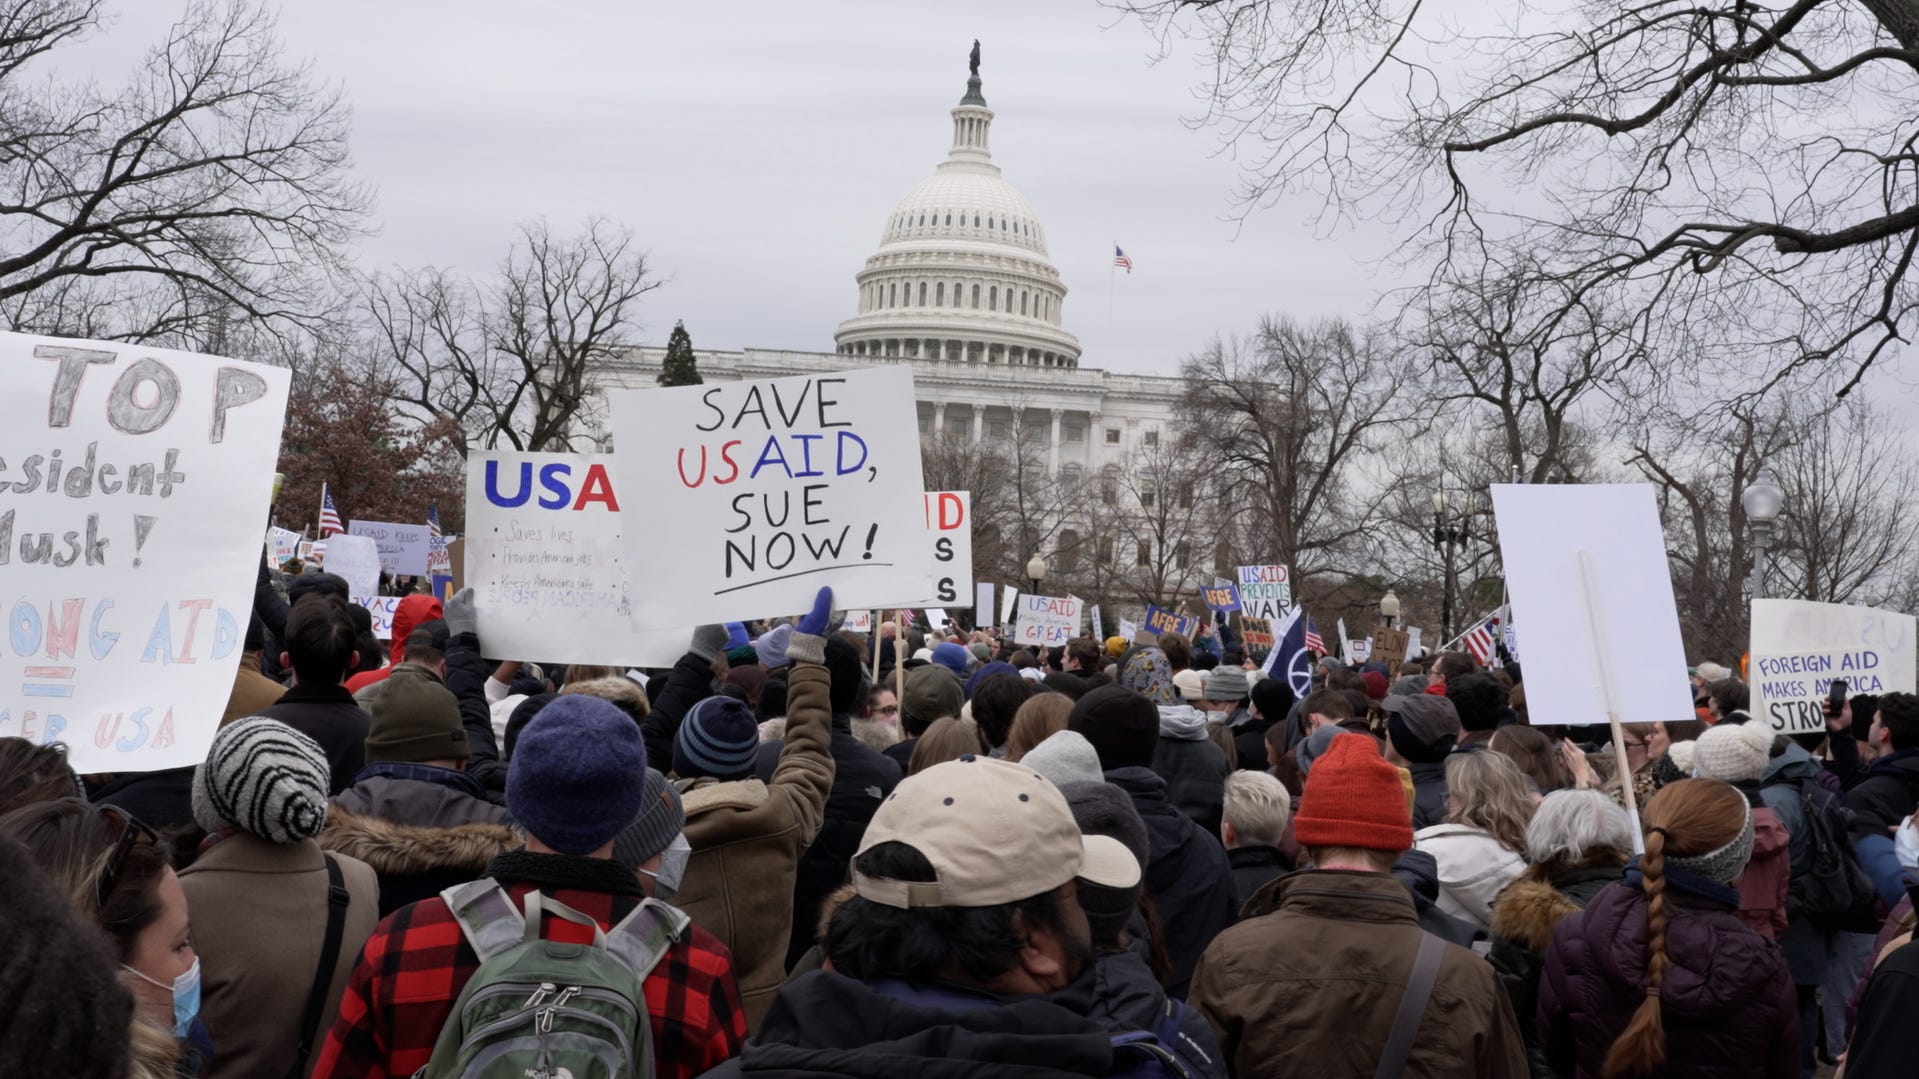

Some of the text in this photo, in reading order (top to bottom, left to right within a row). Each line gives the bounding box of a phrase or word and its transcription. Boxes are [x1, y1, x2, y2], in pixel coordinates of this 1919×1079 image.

[696, 379, 852, 431] SAVE
[678, 431, 877, 488] USAID,
[485, 460, 620, 512] USA
[725, 484, 829, 533] SUE
[505, 519, 573, 543] Saves lives
[1242, 566, 1287, 583] USAID
[1205, 589, 1235, 606] AFGE
[1241, 583, 1290, 600] PREVENTS
[1029, 597, 1076, 617] USAID
[1243, 599, 1290, 619] WAR
[140, 599, 239, 665] AID
[1150, 610, 1181, 633] AFGE
[1026, 626, 1072, 642] GREAT
[1375, 631, 1406, 653] ELON
[1759, 651, 1879, 677] FOREIGN AID
[1762, 675, 1883, 699] MAKES AMRICA
[1770, 700, 1824, 731] STRO
[95, 704, 177, 752] USA
